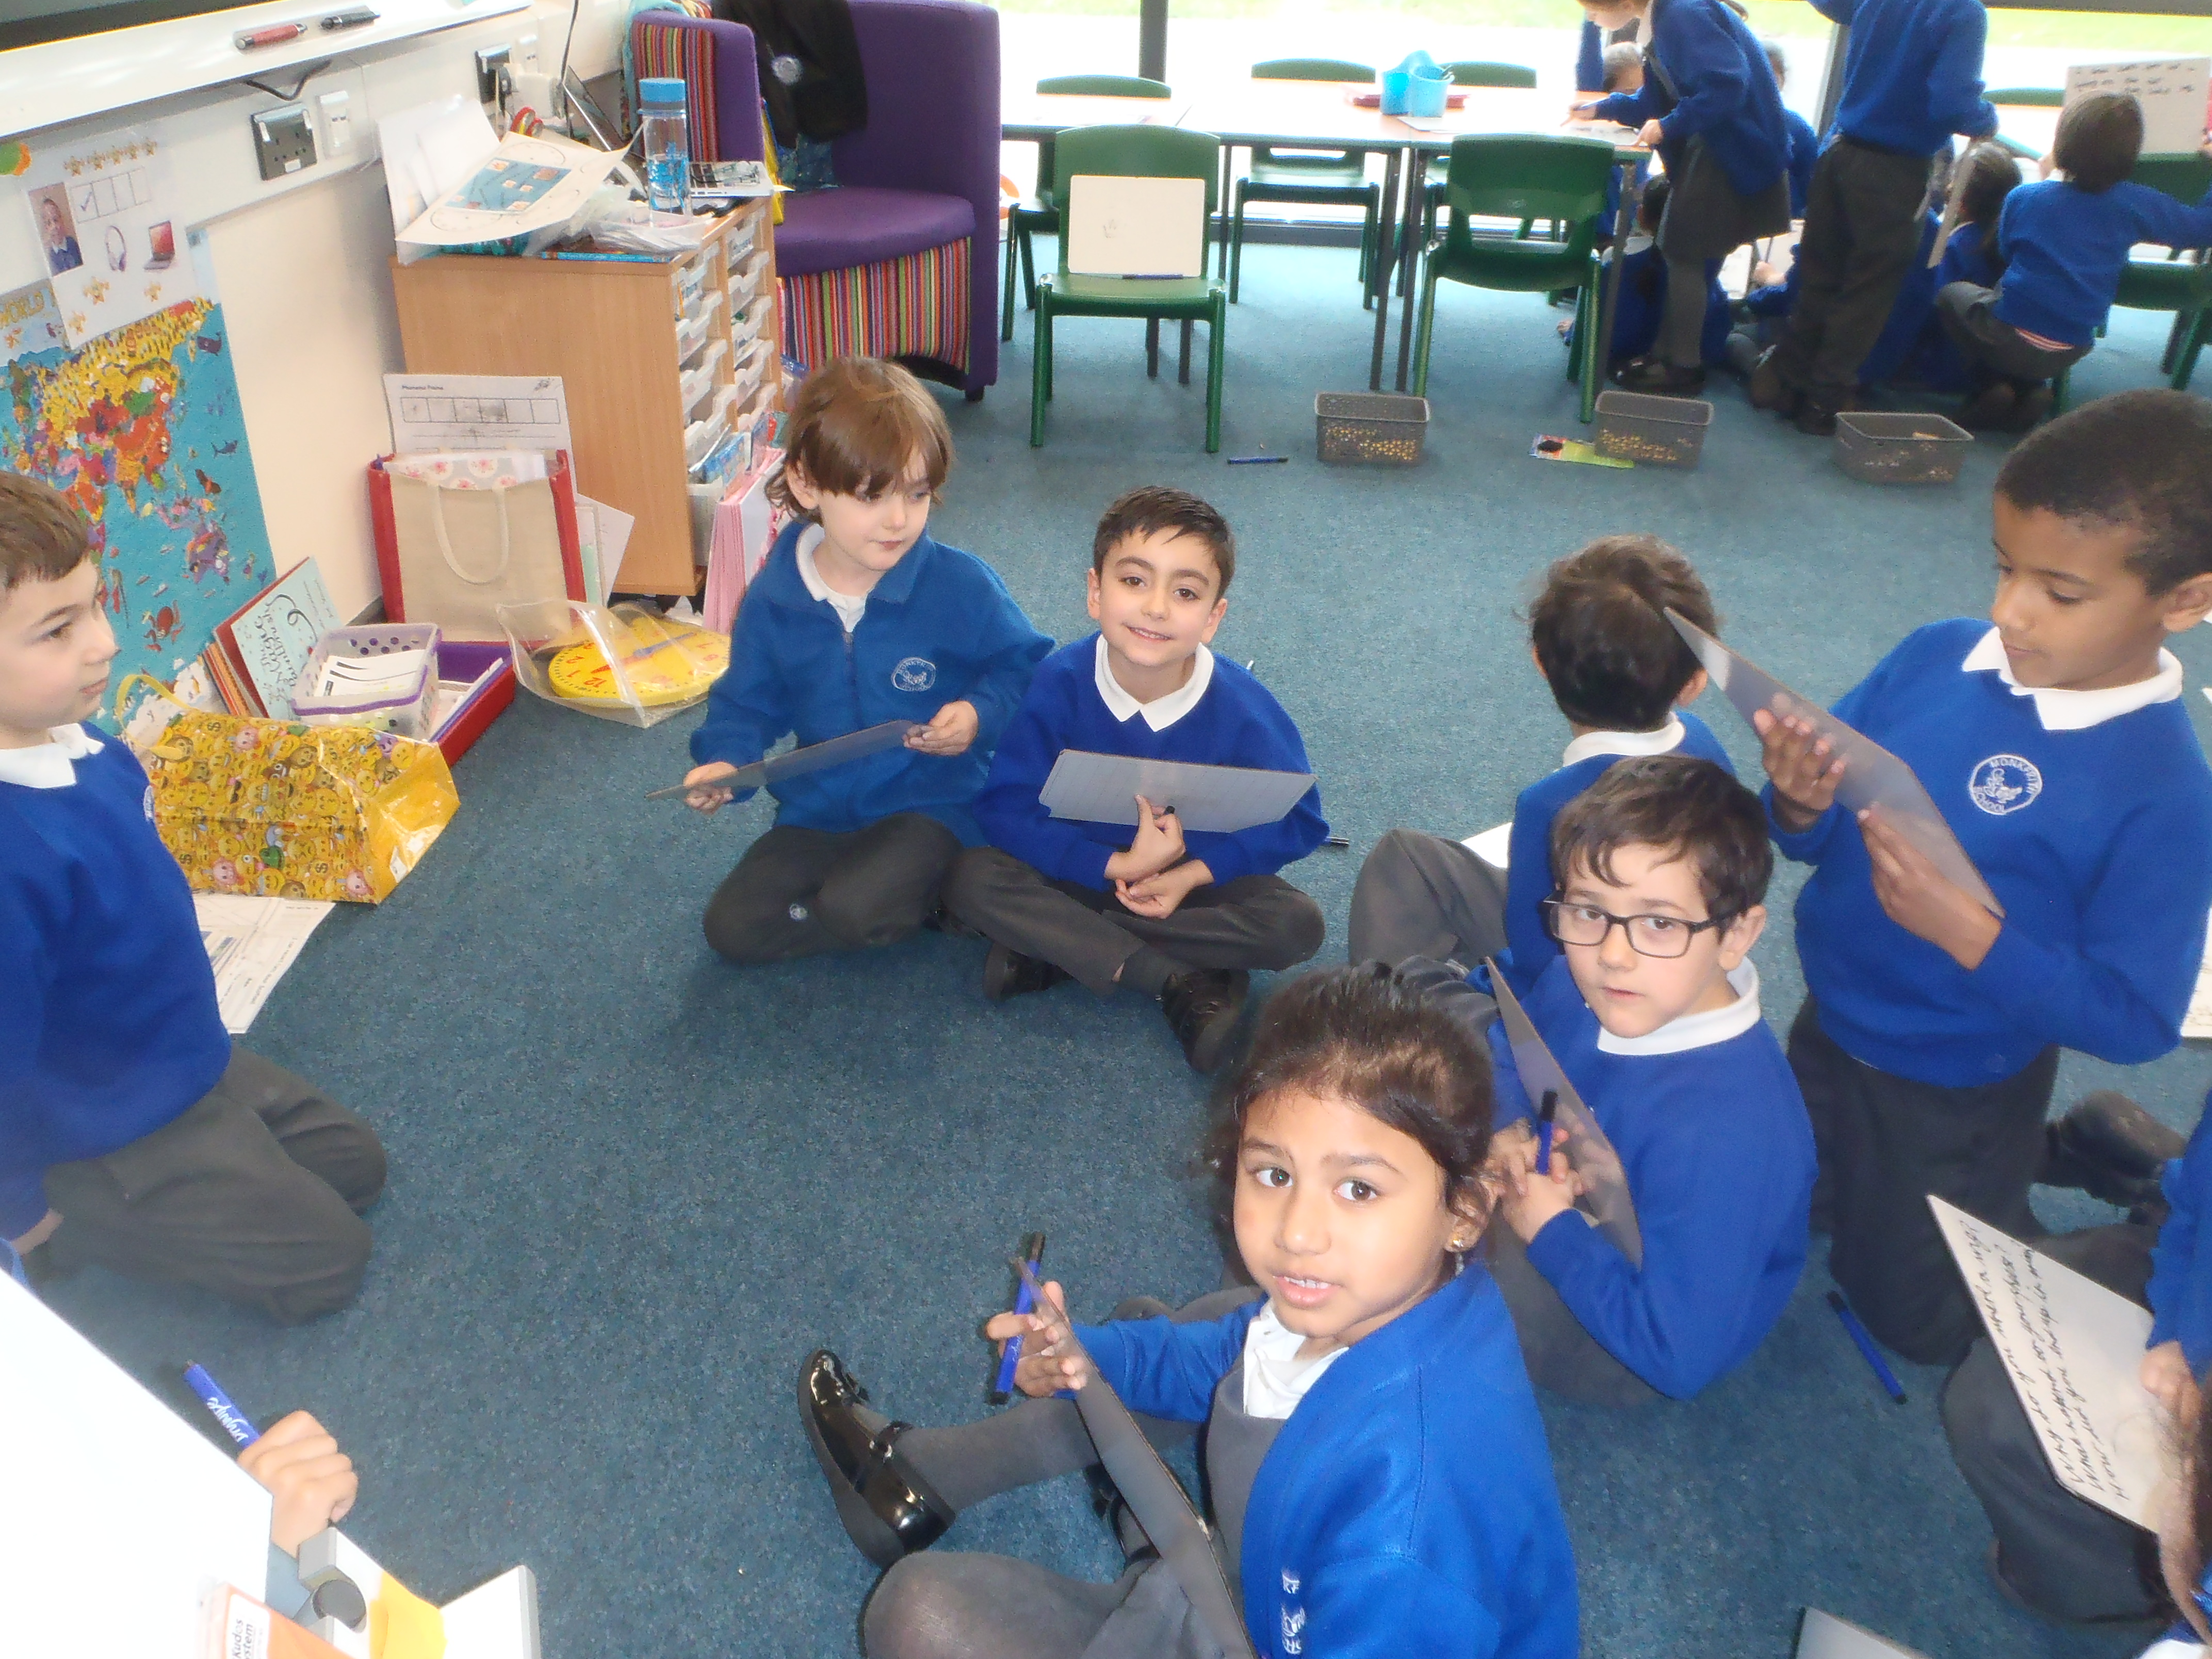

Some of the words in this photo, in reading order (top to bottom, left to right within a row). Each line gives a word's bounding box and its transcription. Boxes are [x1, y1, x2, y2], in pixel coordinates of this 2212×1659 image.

[254, 616, 283, 684] Magic
[583, 677, 607, 688] 12
[2003, 1347, 2036, 1385] you
[2057, 1367, 2087, 1403] you
[2027, 1390, 2052, 1424] do
[2047, 1428, 2086, 1483] Why
[2092, 1442, 2130, 1500] How
[242, 1623, 253, 1659] stem
